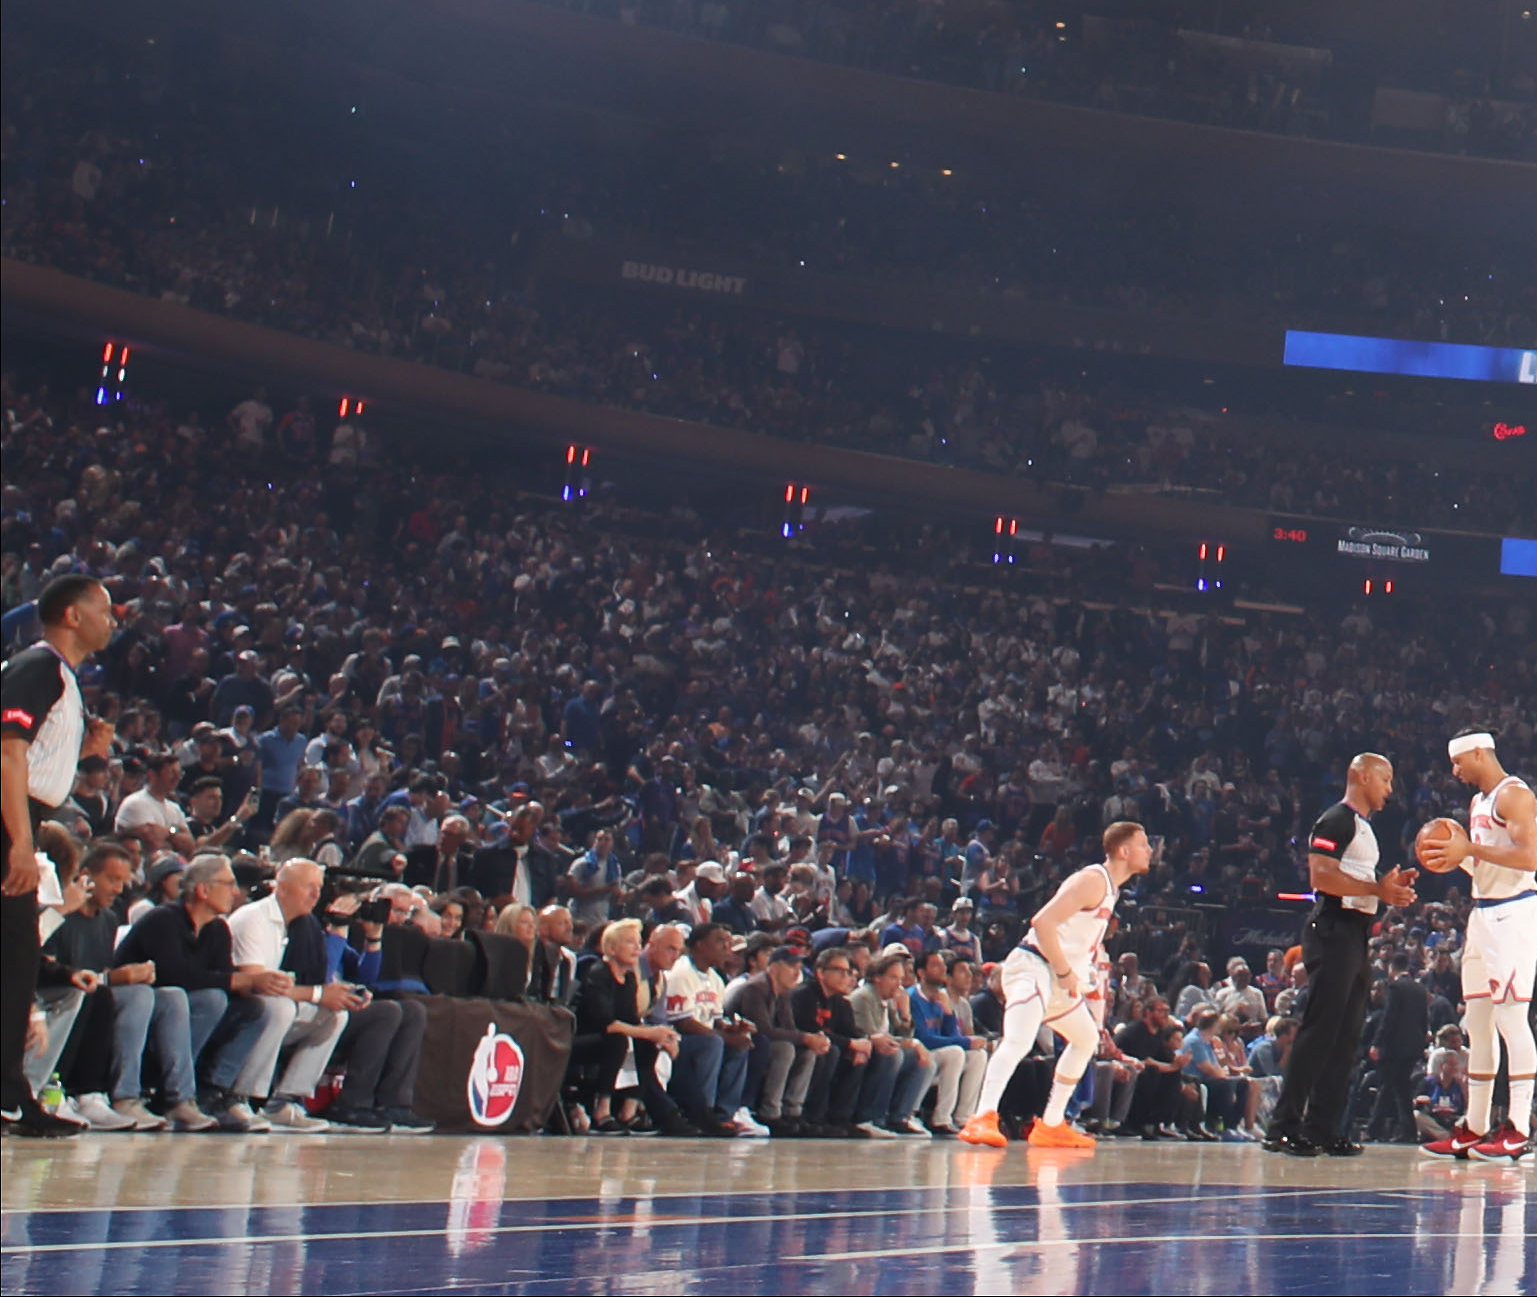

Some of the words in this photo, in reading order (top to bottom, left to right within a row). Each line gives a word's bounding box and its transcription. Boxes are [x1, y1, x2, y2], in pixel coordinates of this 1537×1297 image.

[621, 260, 674, 284] BUD
[675, 267, 748, 295] LIGHT
[1273, 527, 1308, 542] 3:40
[1338, 539, 1371, 554] MADISON
[1372, 543, 1399, 558] SQUARE
[1401, 546, 1430, 560] GARDEN
